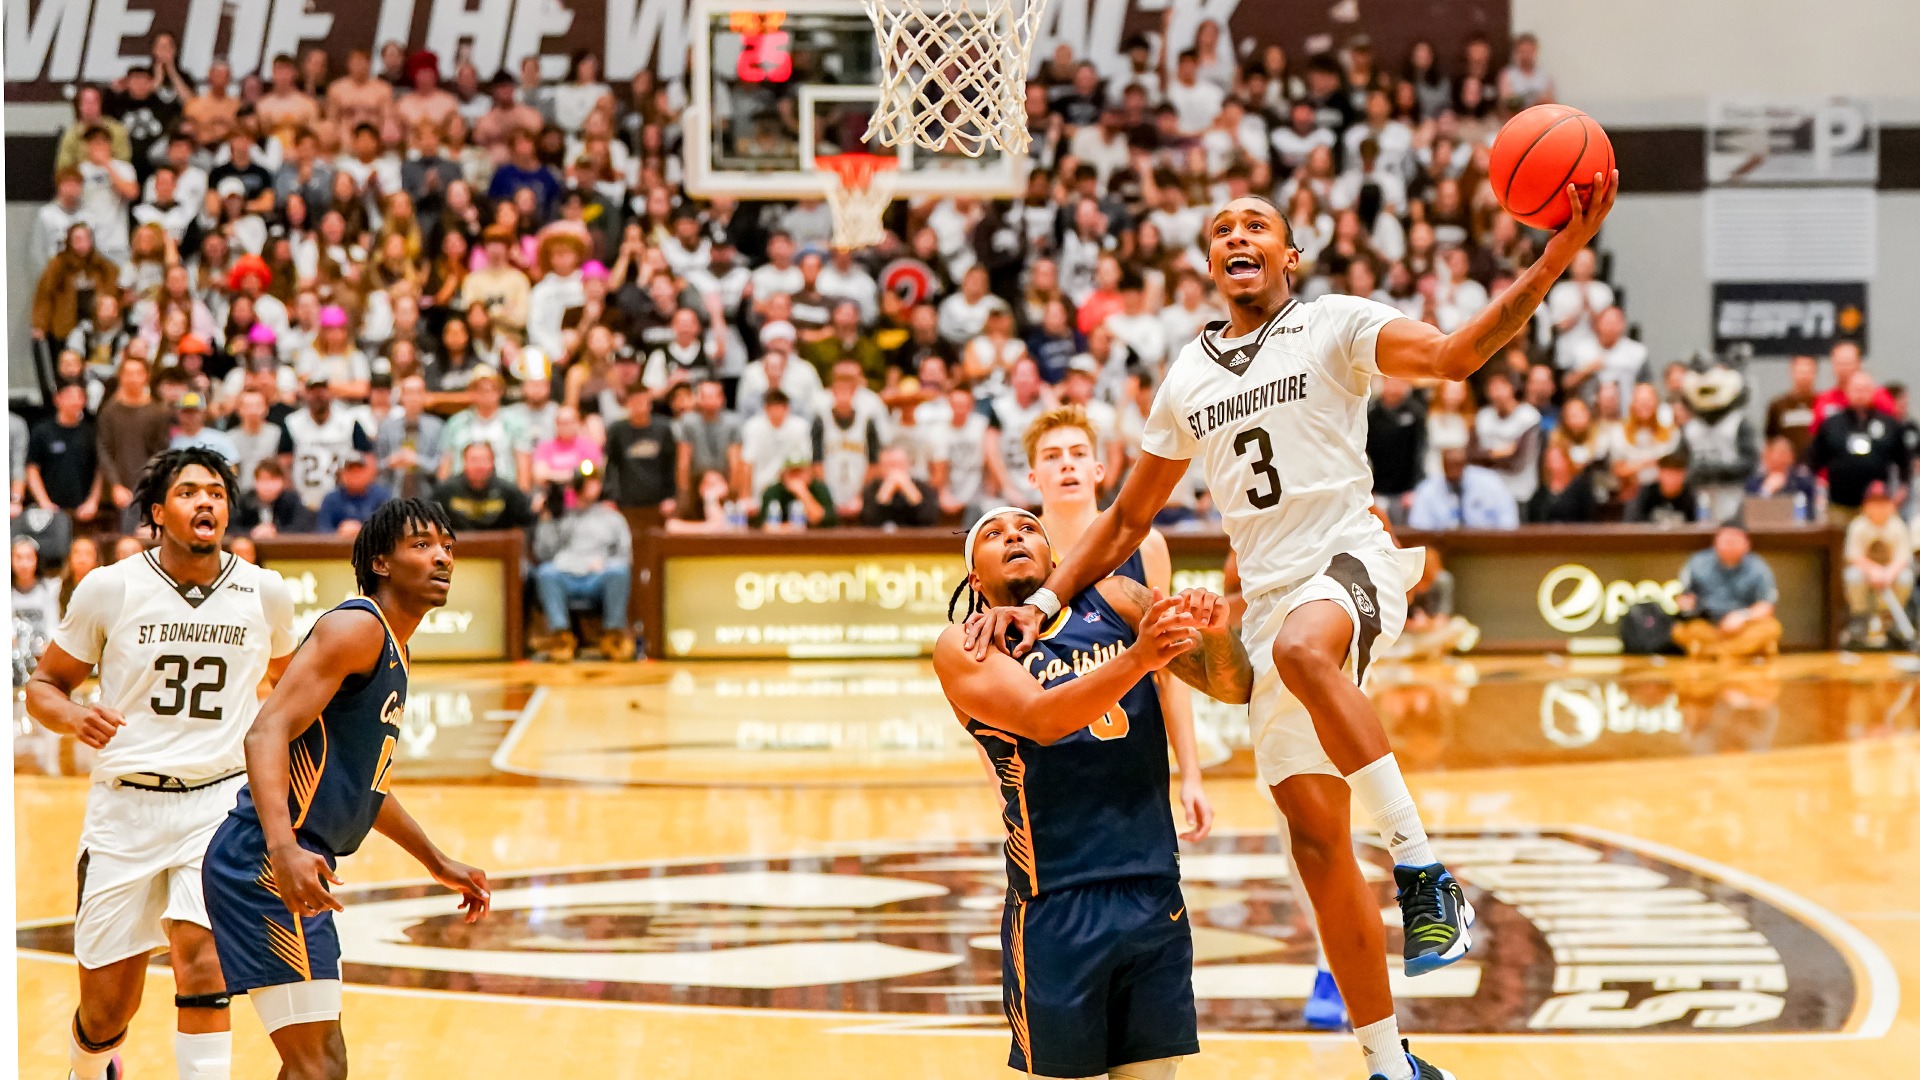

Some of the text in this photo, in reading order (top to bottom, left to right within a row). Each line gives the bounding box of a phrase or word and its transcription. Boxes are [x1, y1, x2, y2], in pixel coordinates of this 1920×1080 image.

[1187, 372, 1308, 441] ST. BONAVENTURE
[1233, 426, 1282, 510] 3
[138, 622, 248, 647] ST. BONAVENTURE
[150, 654, 228, 721] 32
